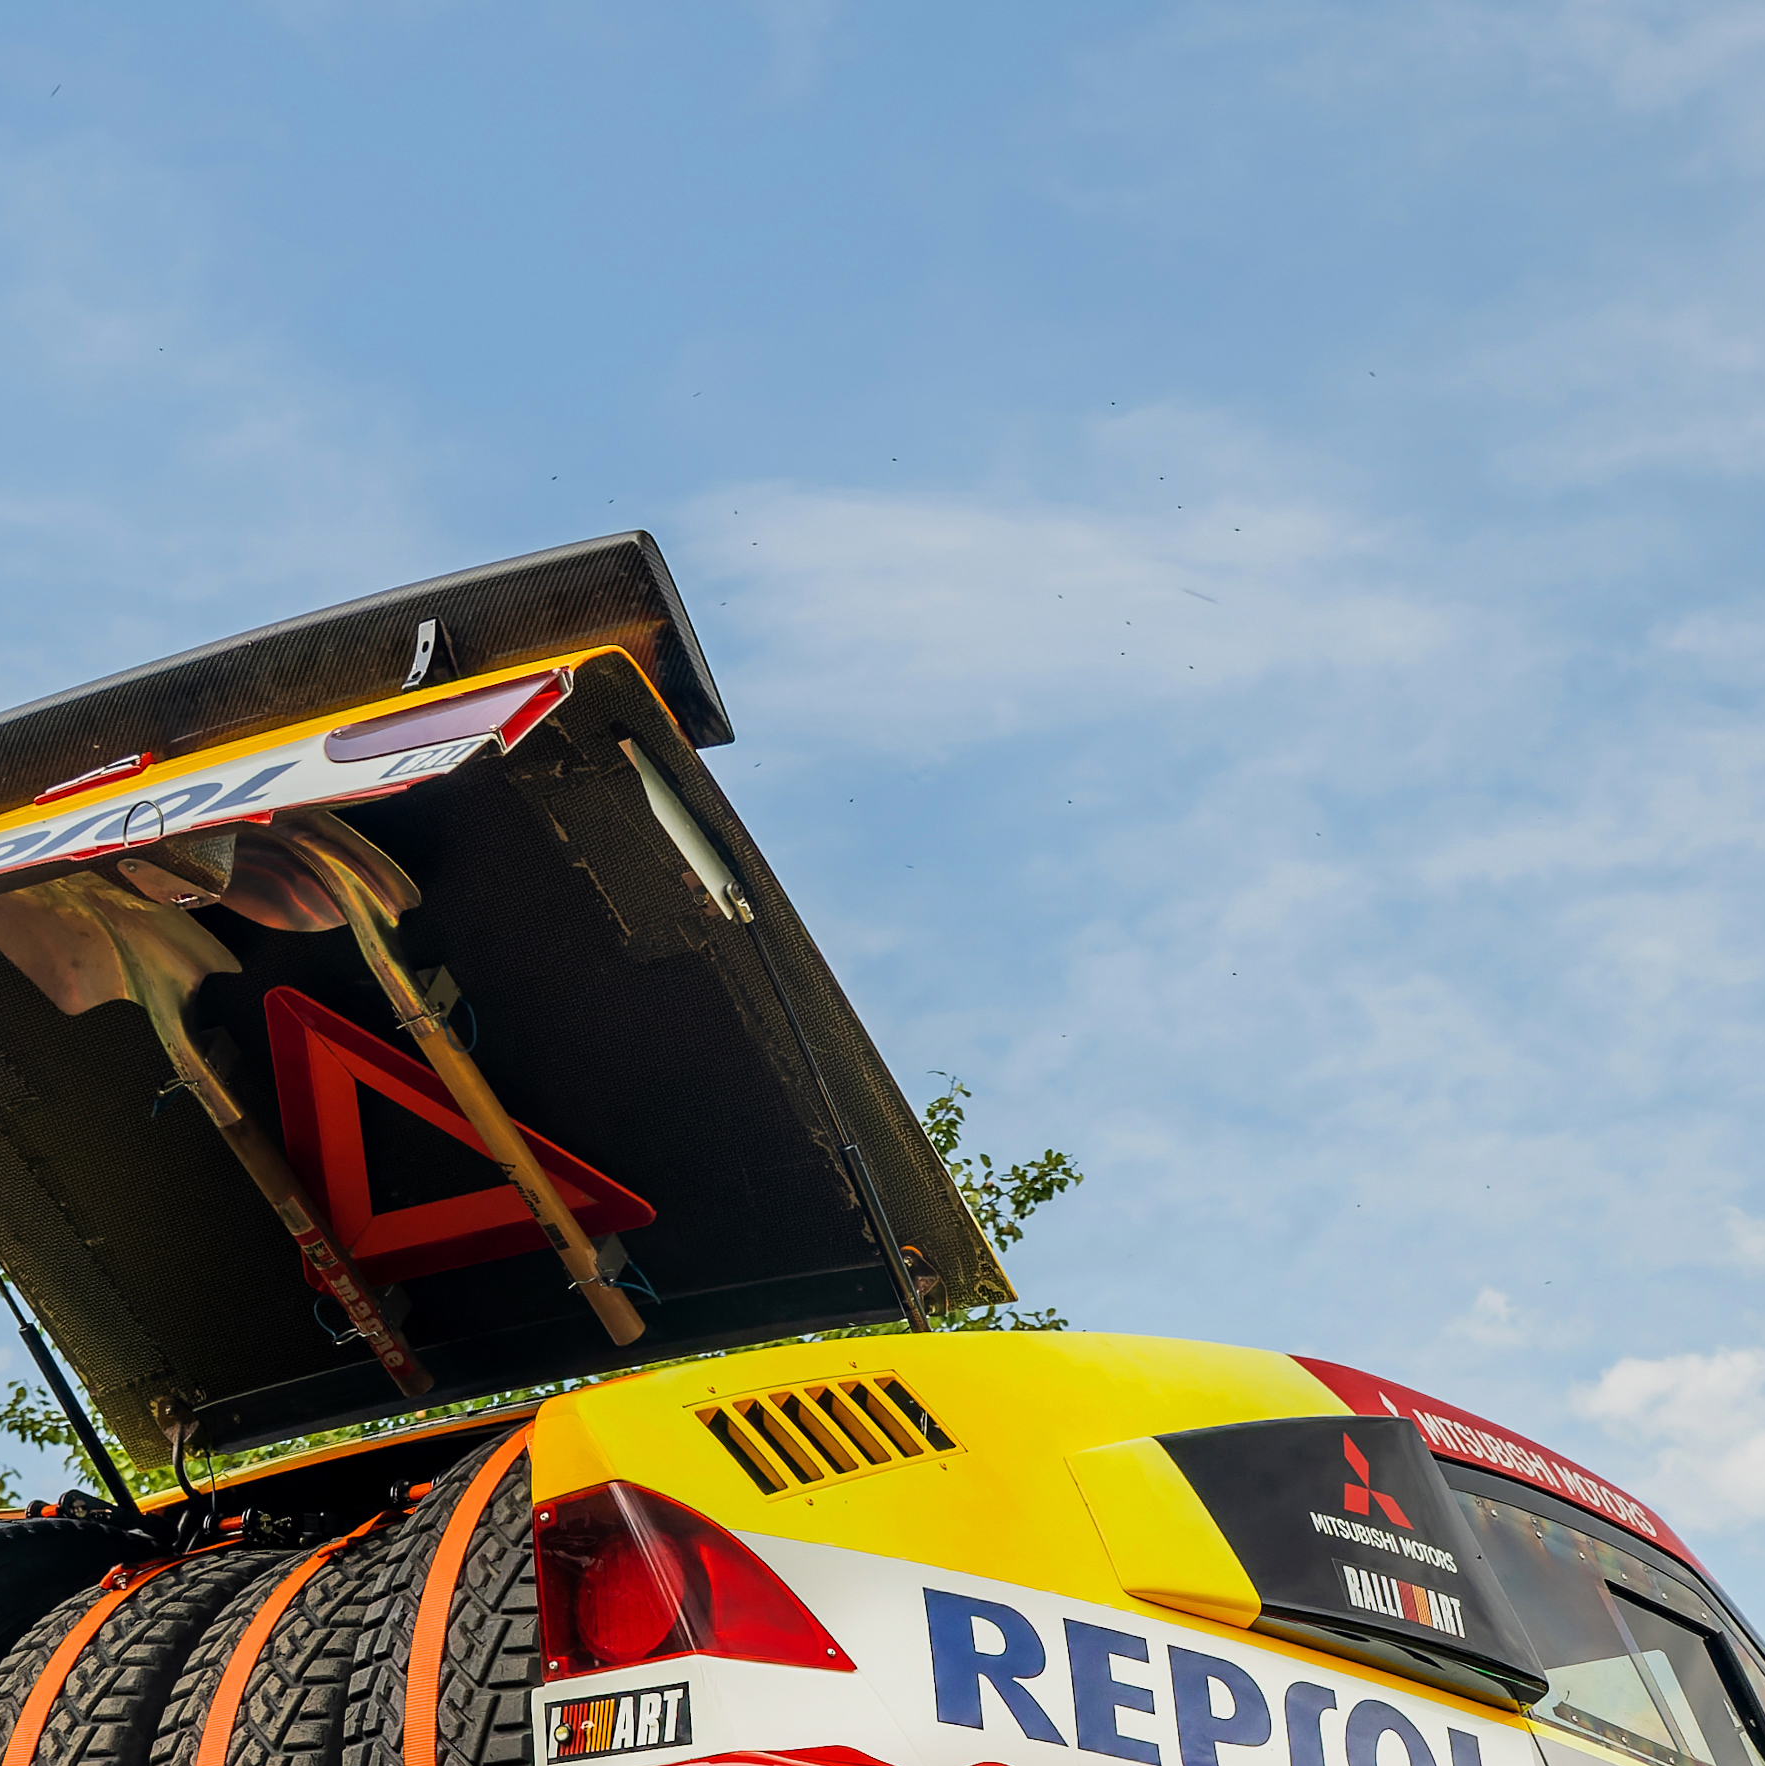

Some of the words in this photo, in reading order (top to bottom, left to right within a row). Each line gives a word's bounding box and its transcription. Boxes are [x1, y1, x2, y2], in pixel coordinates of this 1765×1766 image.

[1415, 1408, 1564, 1493] MITSUBISHI
[1560, 1460, 1657, 1538] MOTORS
[1310, 1511, 1400, 1554] MITSUBISHI
[1402, 1535, 1459, 1575] MOTORS
